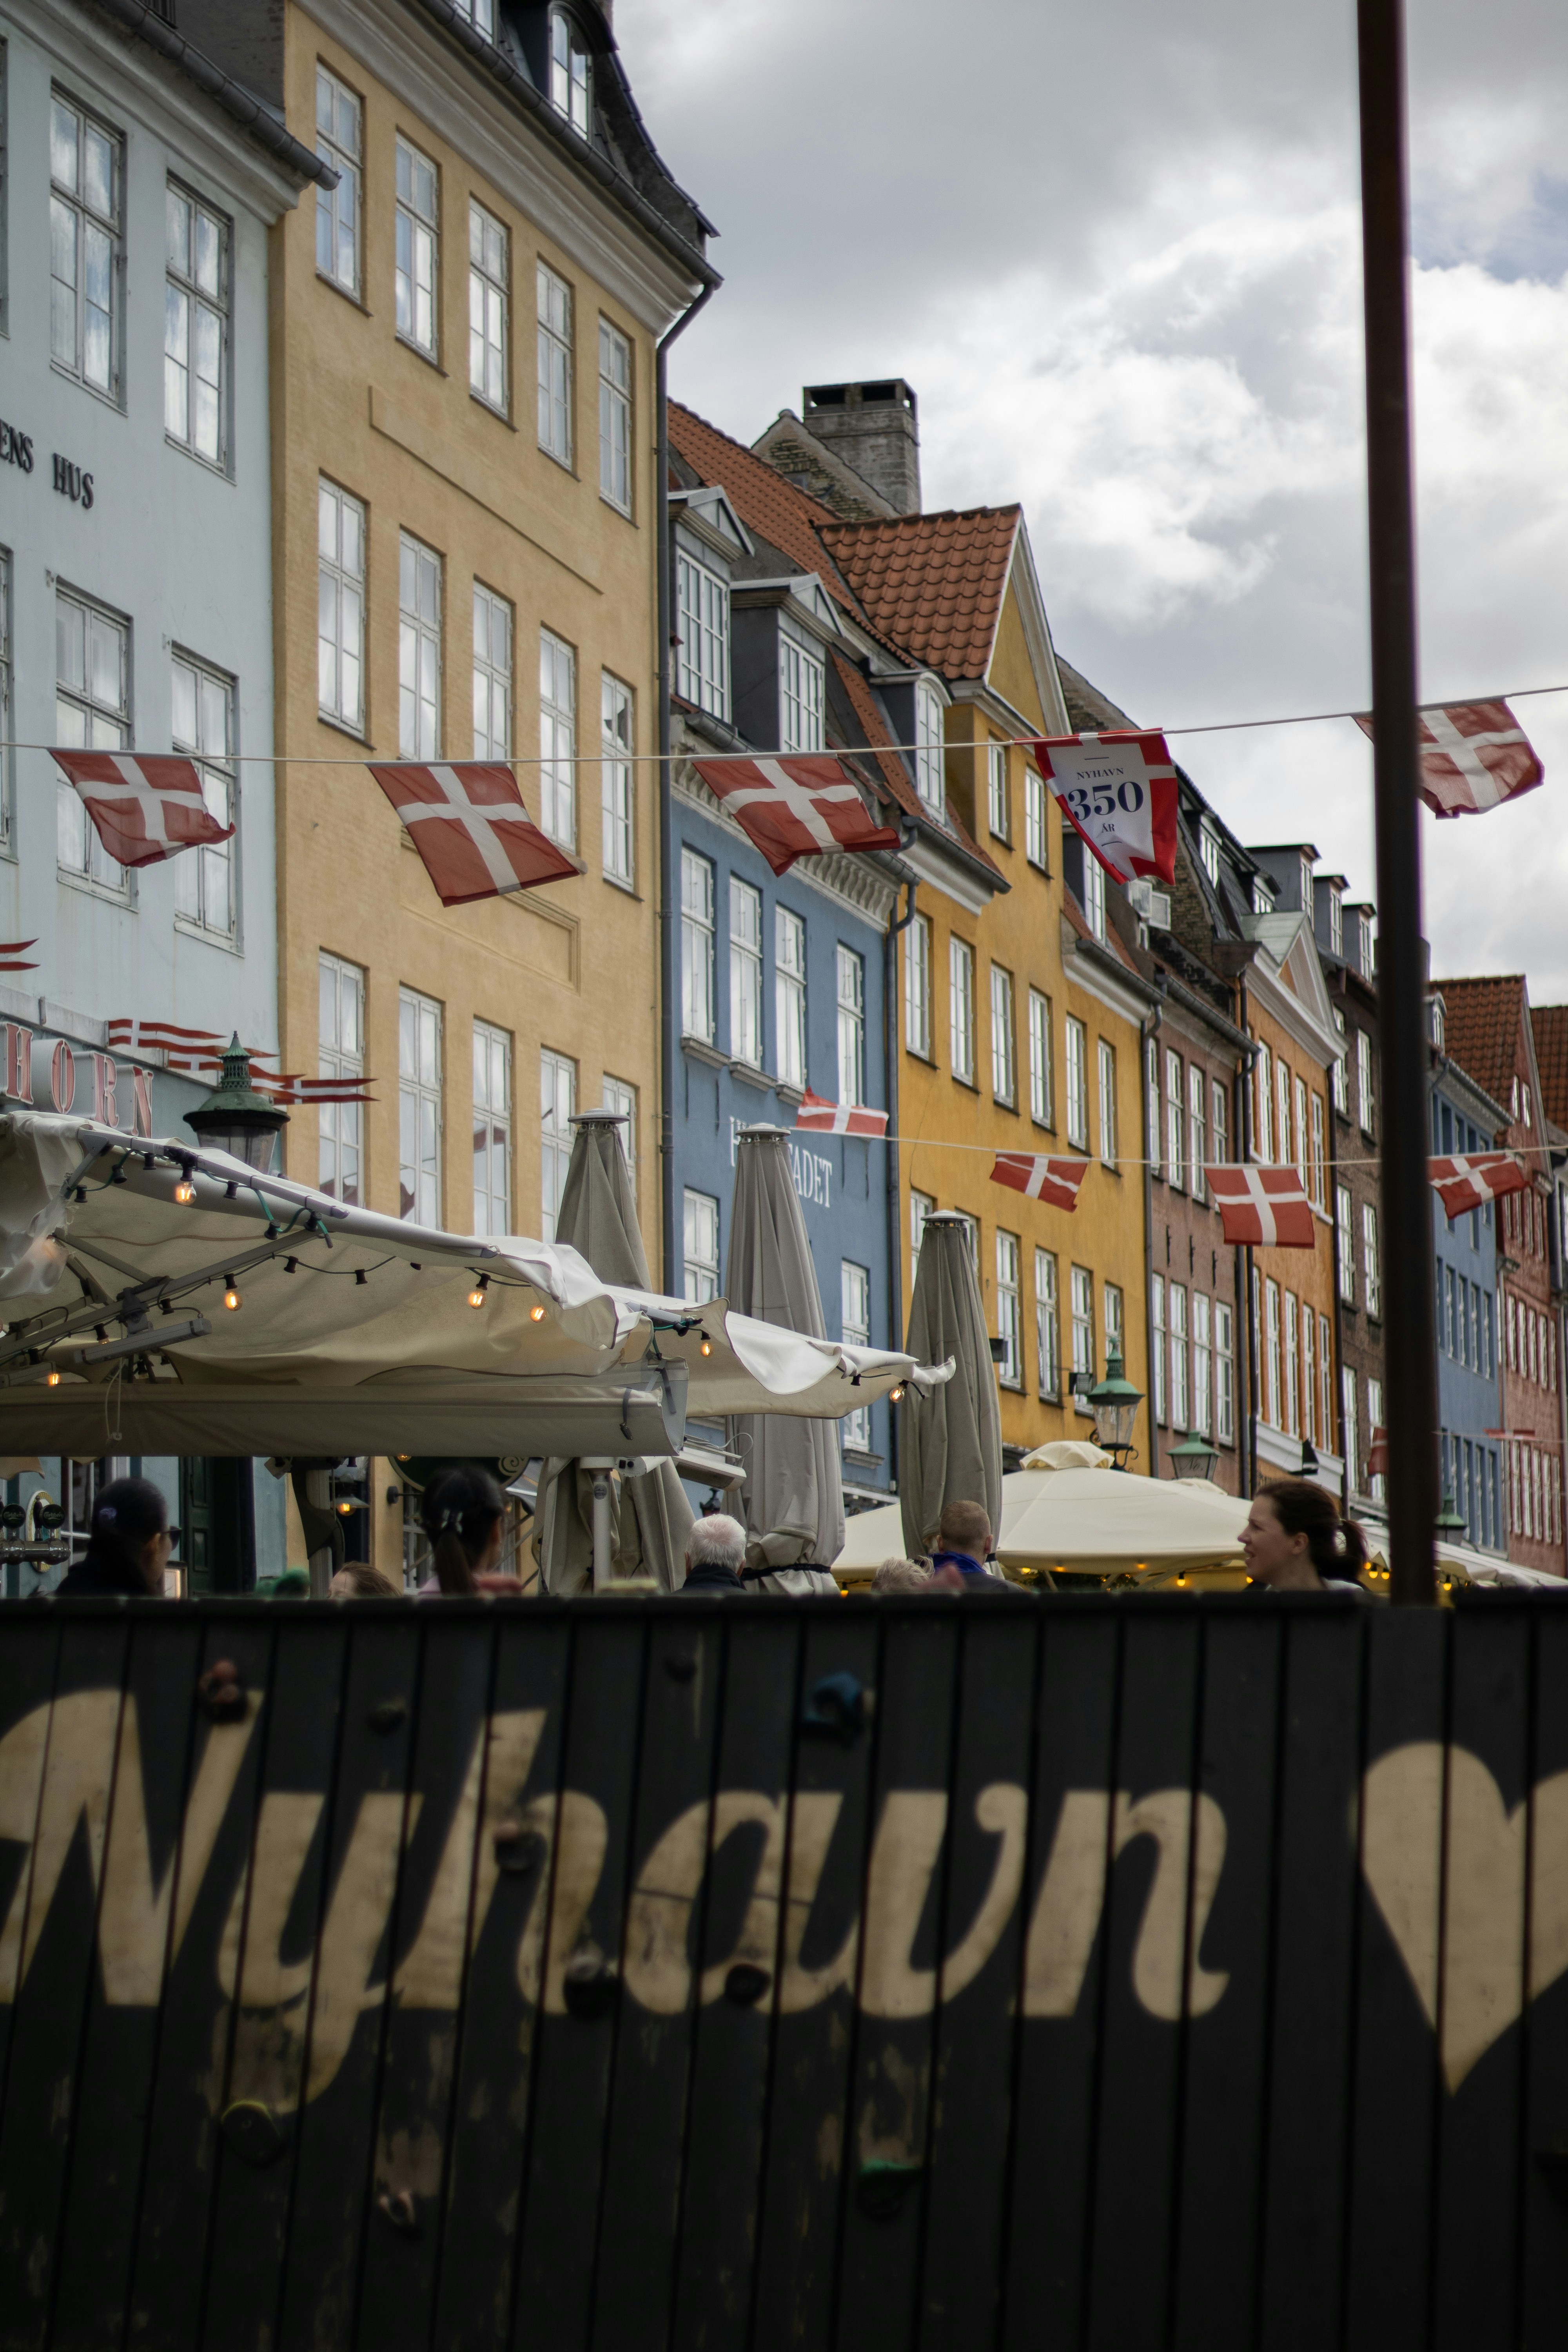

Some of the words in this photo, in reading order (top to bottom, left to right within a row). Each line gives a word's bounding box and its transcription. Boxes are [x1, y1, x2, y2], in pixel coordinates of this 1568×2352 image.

[53, 452, 94, 509] HUS
[1076, 768, 1125, 780] NYHAVN
[1068, 781, 1144, 821] 350
[1101, 823, 1116, 833] ÅR
[5, 1022, 153, 1139] HORN
[0, 1686, 1230, 2116] Nyhavn
